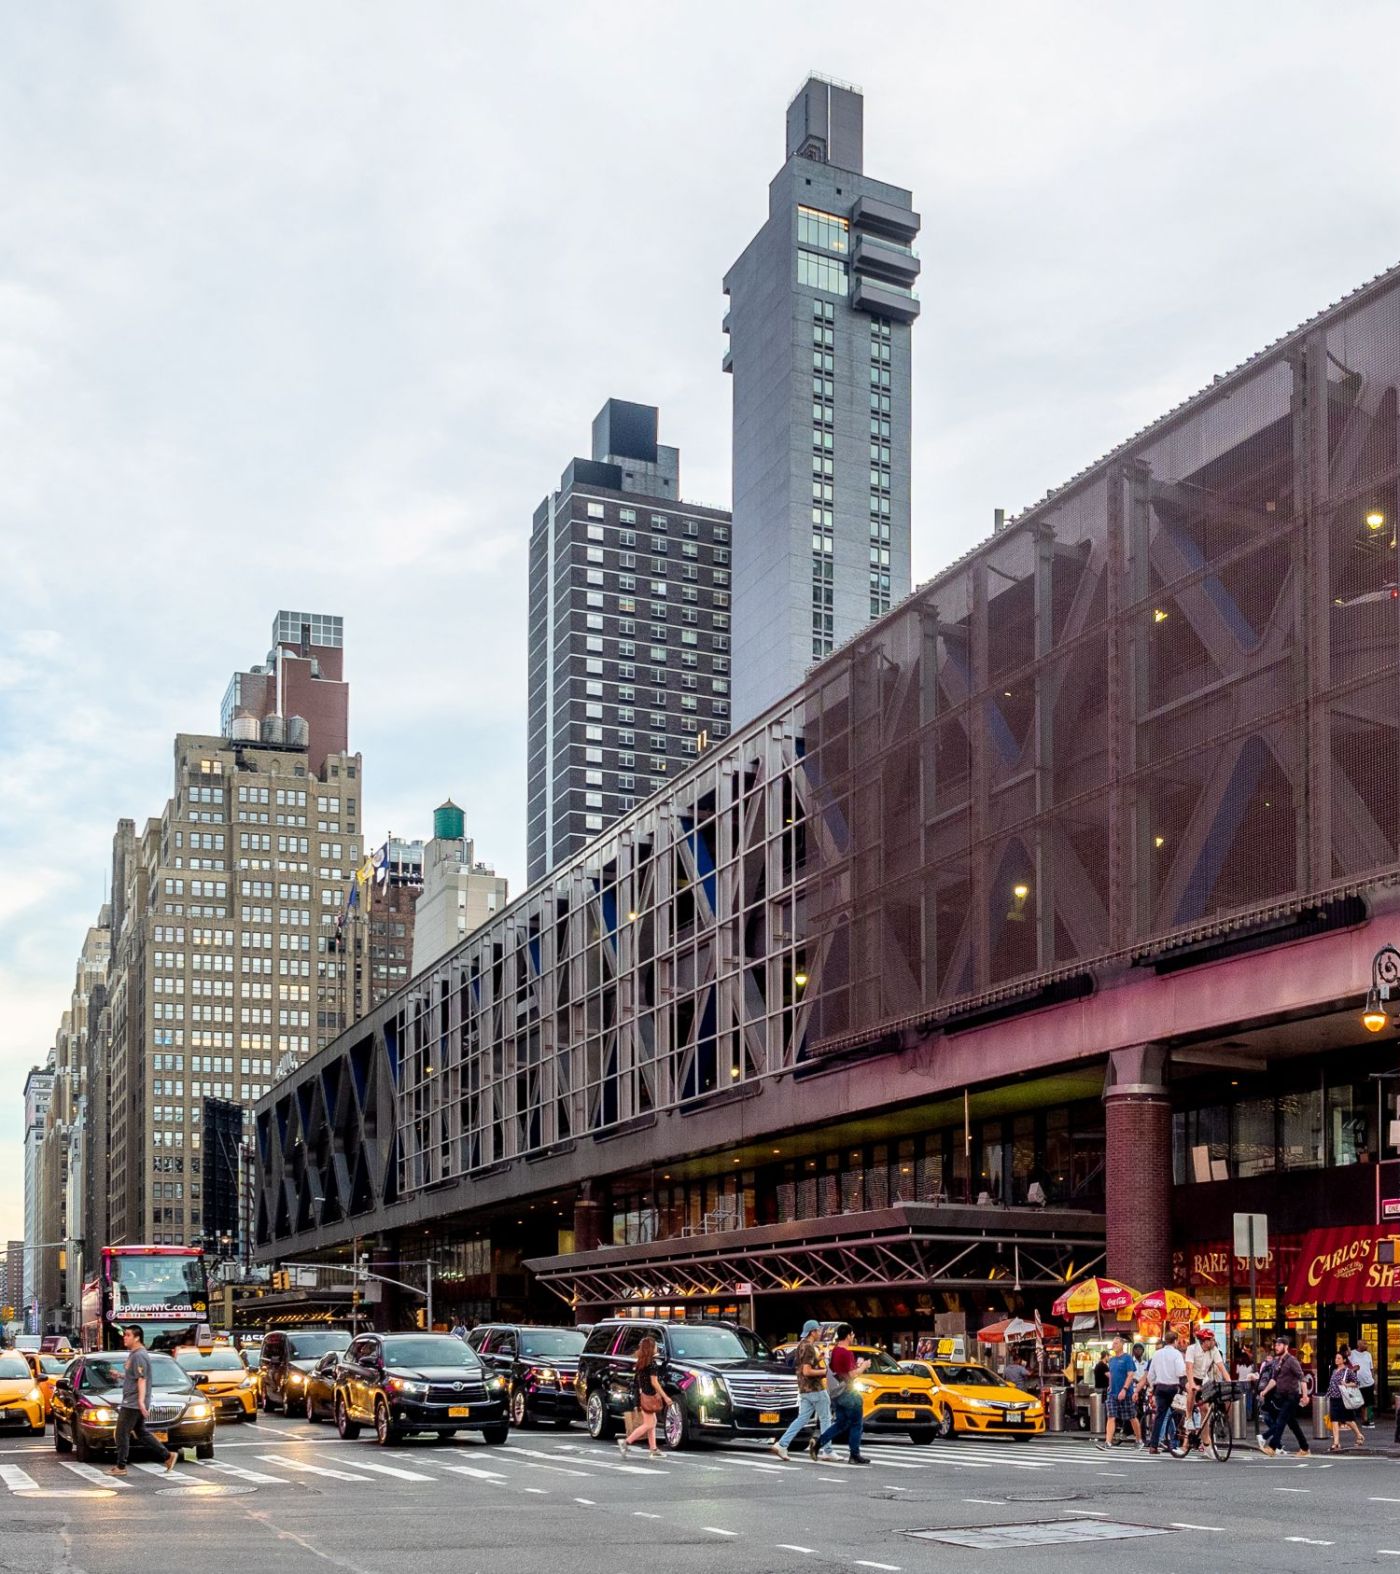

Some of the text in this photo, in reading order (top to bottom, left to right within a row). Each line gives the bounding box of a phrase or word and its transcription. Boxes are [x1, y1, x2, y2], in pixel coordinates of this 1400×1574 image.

[1388, 1205, 1398, 1213] ONE
[1194, 1252, 1228, 1273] BAKE
[1308, 1239, 1371, 1287] CARLO'S
[118, 1303, 192, 1312] opViewNYC.com
